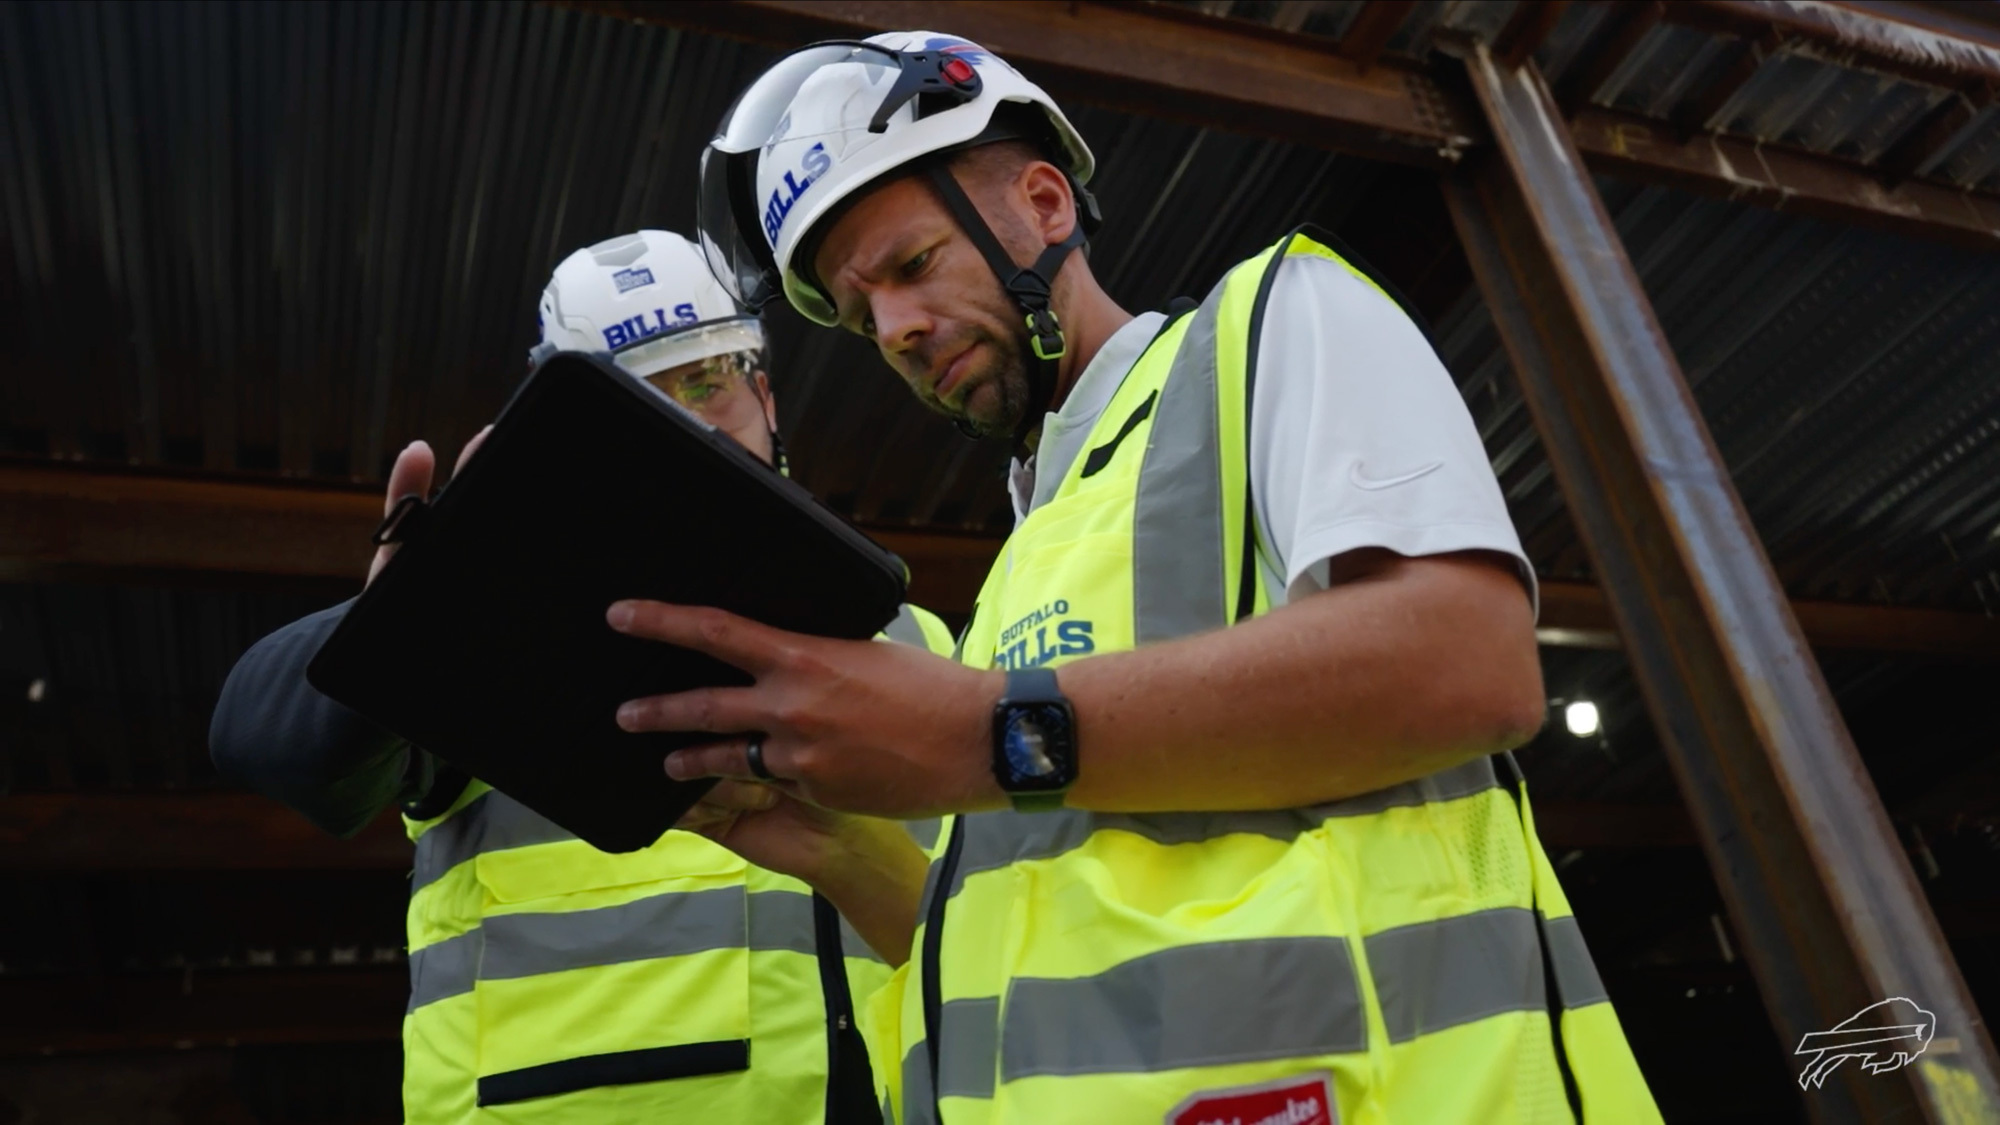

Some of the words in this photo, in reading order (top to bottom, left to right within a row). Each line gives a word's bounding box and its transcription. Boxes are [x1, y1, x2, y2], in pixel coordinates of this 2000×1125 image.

[765, 142, 831, 250] BILLS
[602, 303, 698, 350] BILLS
[1001, 599, 1068, 647] BUFFALO
